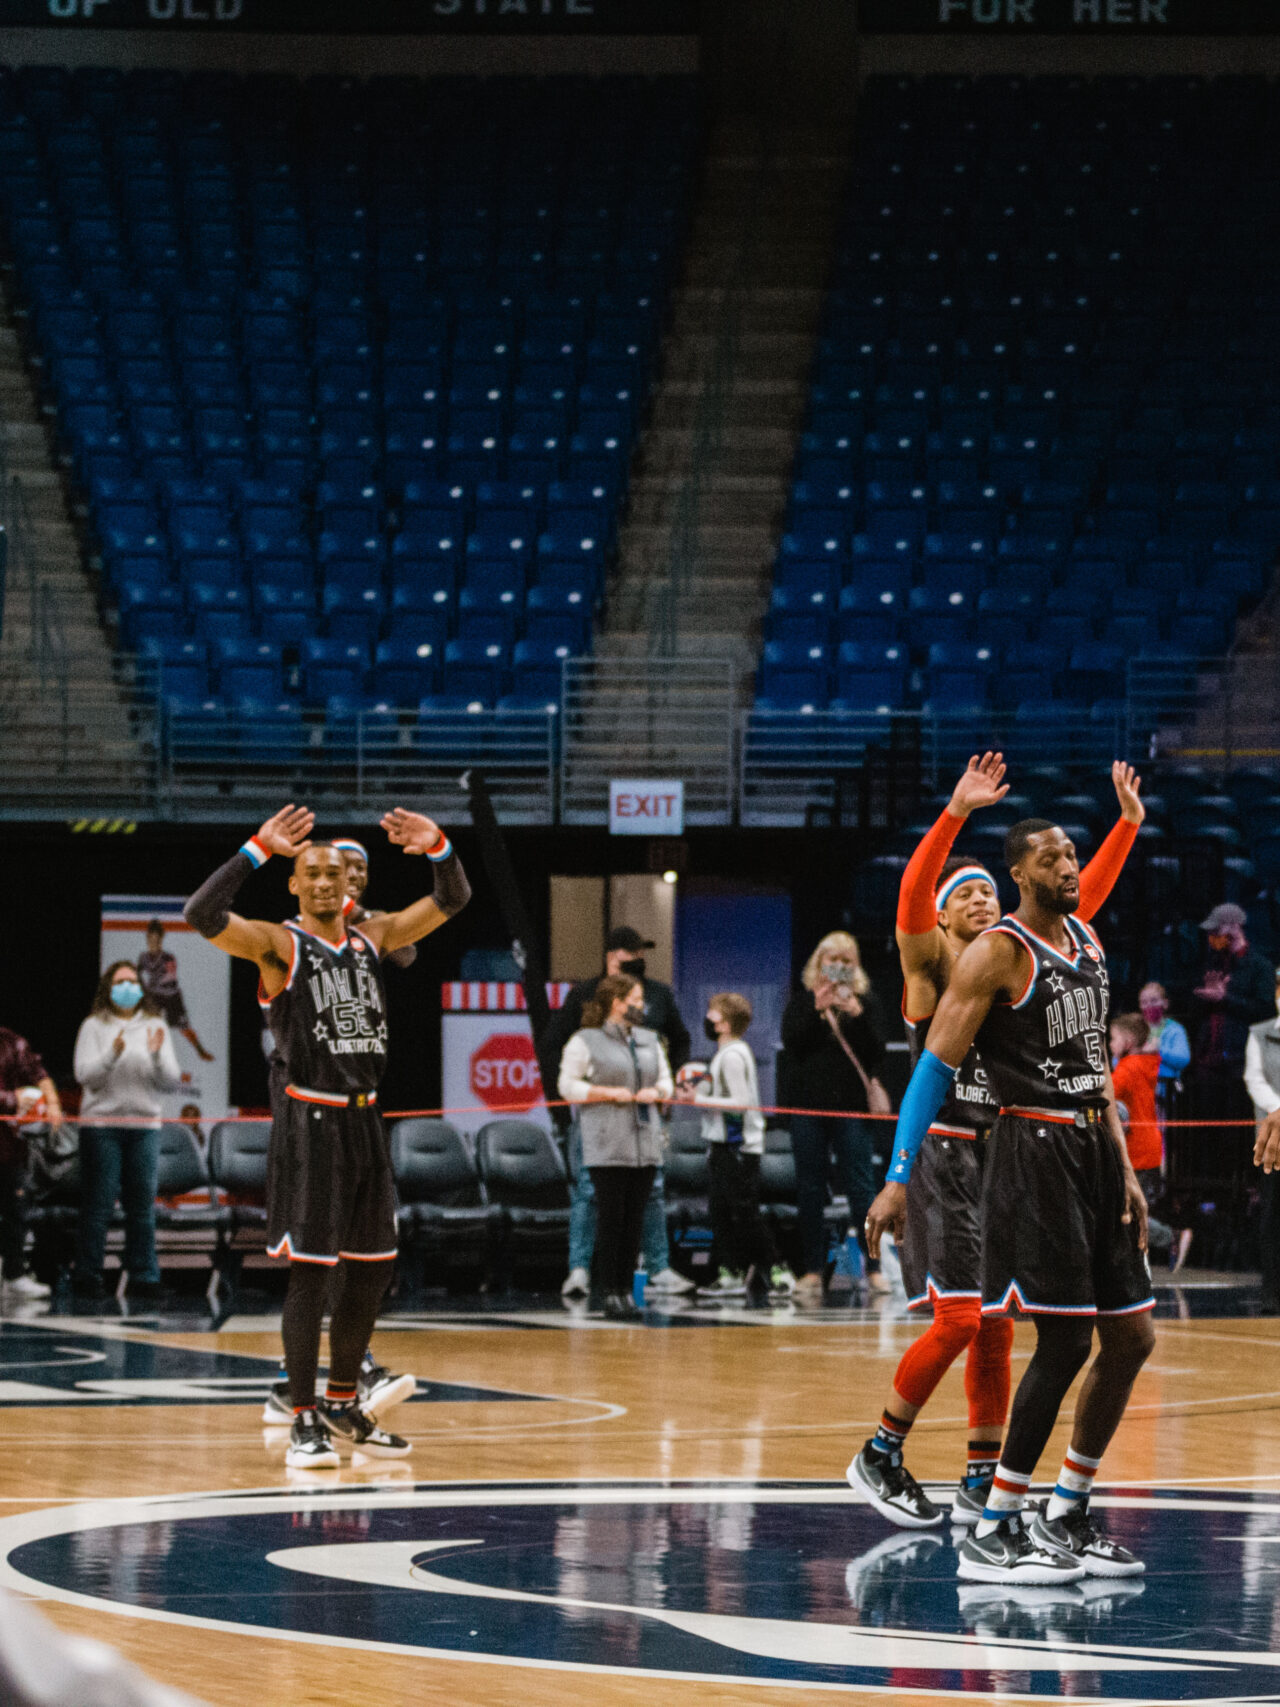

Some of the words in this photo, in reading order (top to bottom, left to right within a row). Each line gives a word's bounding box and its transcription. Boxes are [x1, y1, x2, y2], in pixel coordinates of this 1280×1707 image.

[937, 0, 1036, 23] FOR
[1072, 0, 1169, 23] HER
[616, 794, 677, 817] EXIT
